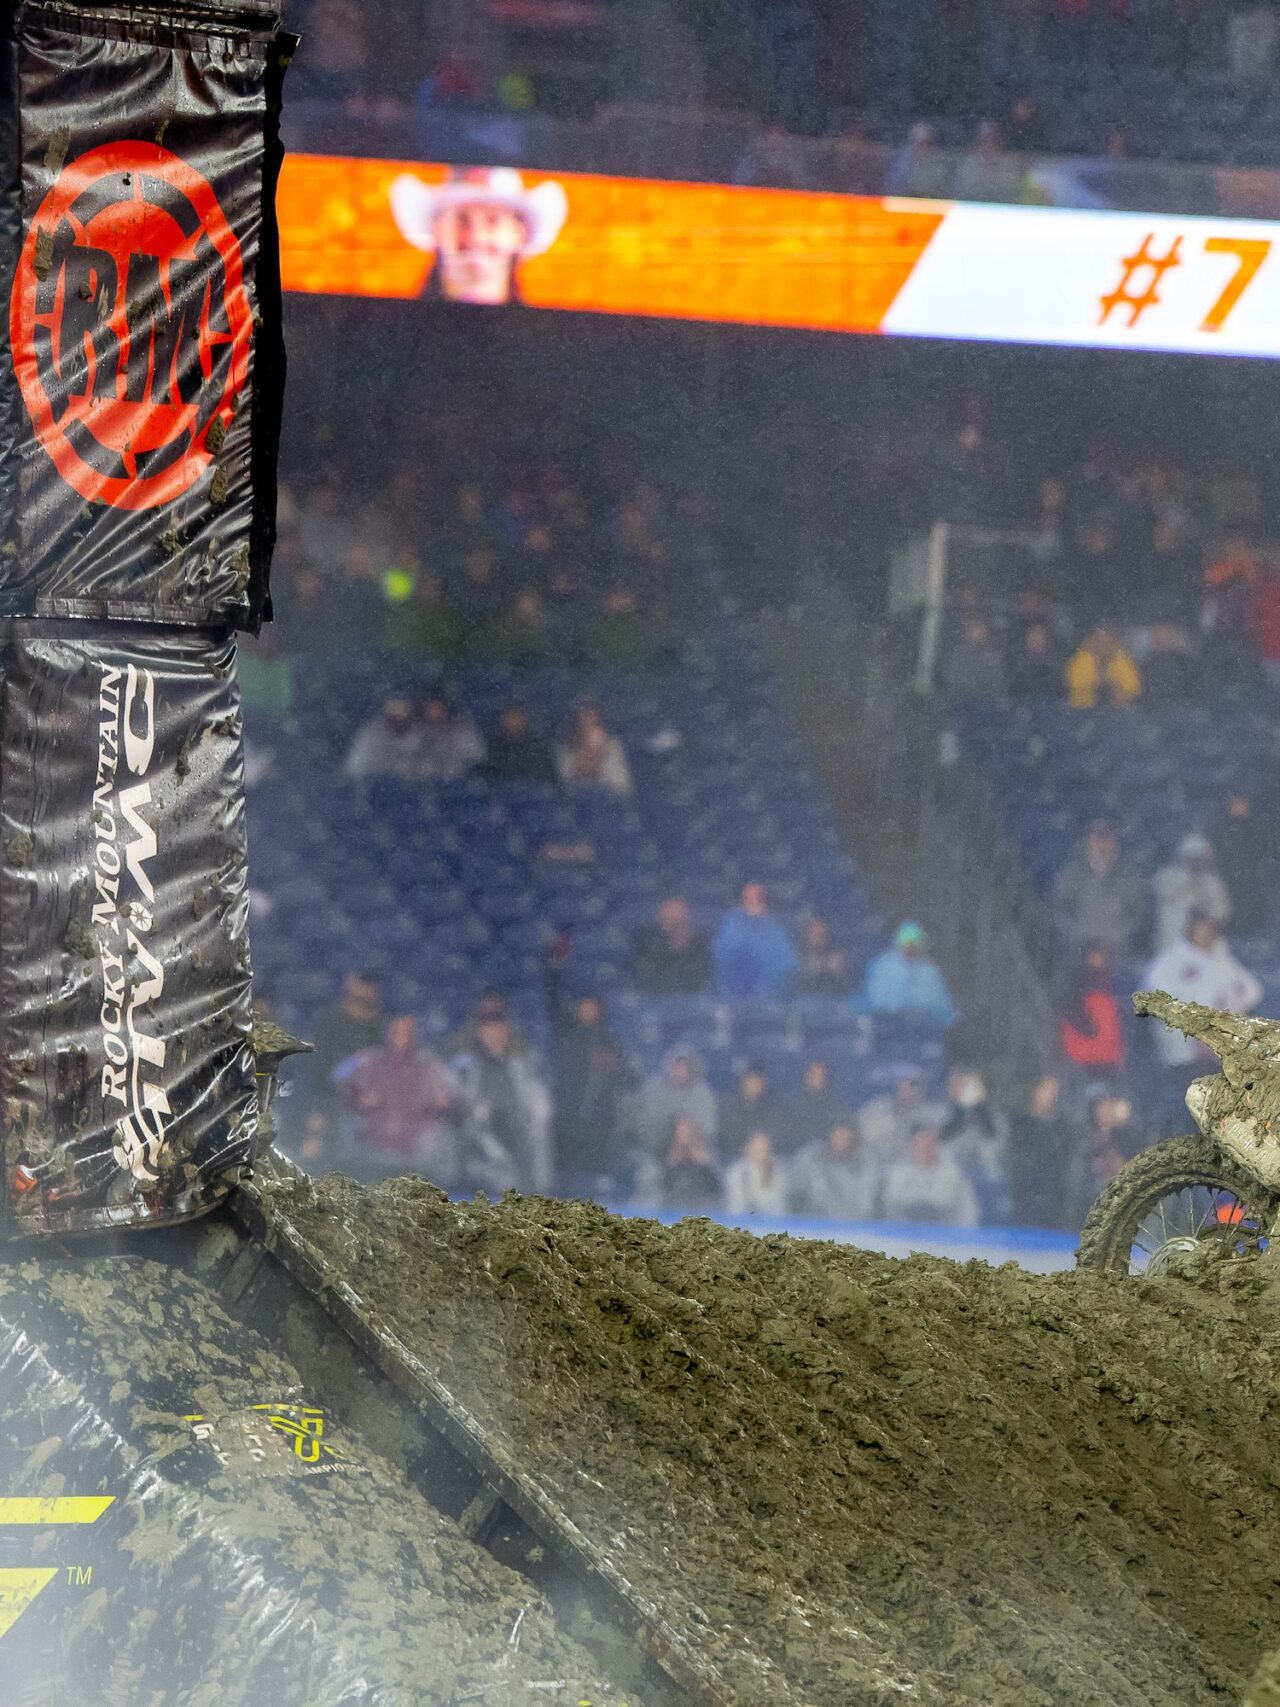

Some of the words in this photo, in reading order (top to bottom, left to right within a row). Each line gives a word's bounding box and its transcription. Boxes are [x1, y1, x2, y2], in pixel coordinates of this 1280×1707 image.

[1096, 232, 1273, 333] #7
[91, 660, 122, 932] MOUNTAIN
[99, 943, 127, 1107] ROCKY
[66, 1565, 93, 1586] TM
